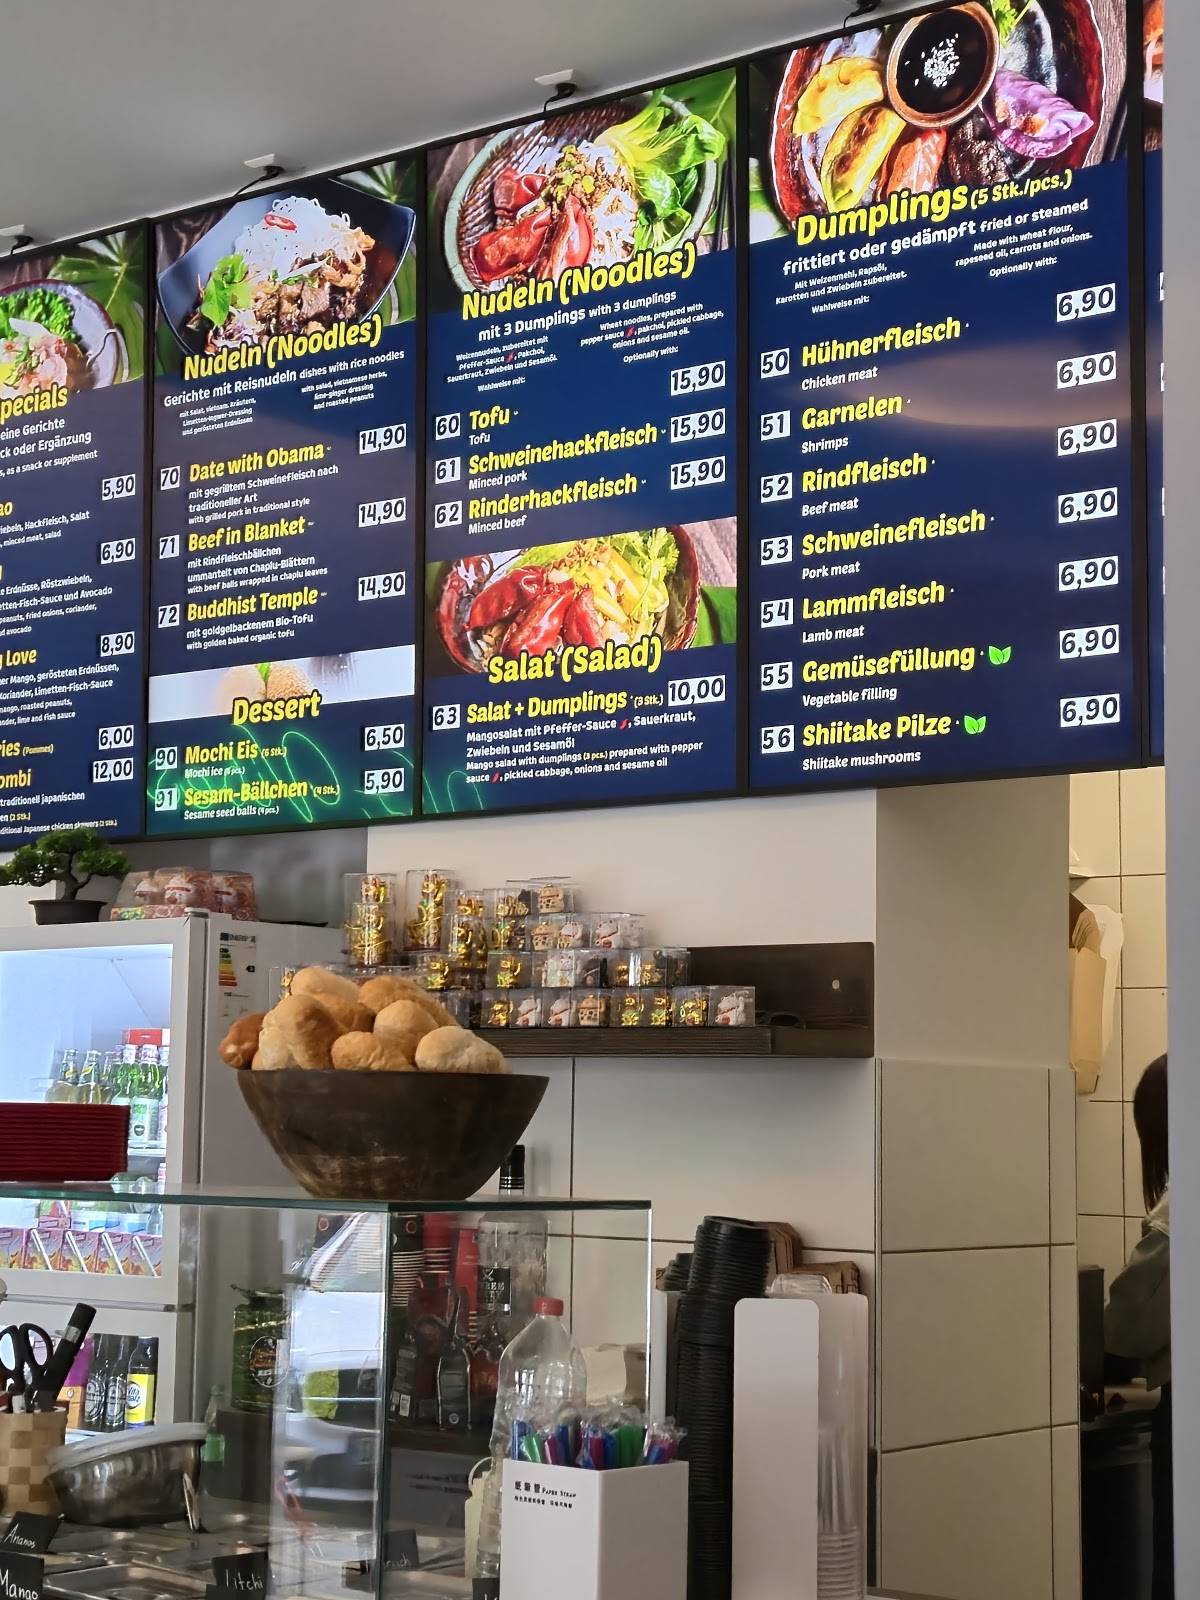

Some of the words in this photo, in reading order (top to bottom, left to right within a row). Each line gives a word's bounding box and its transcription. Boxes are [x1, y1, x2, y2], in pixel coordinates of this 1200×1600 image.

[797, 185, 968, 245] Dumplings
[971, 185, 988, 209] (5
[992, 169, 1072, 202] Stk./pcs.)
[782, 244, 846, 276] frittiert
[849, 242, 886, 261] oder
[891, 221, 976, 254] gedämpft
[980, 216, 1012, 233] fried
[1015, 211, 1028, 225] or
[1031, 199, 1088, 222] steamed
[974, 238, 998, 251] Made
[999, 234, 1018, 246] with
[1019, 228, 1047, 243] wheat
[1048, 224, 1073, 238] flour,
[462, 278, 553, 320] Nudeln
[560, 242, 696, 304] (Noodles)
[479, 326, 500, 342] mit
[504, 323, 512, 334] 3
[515, 308, 585, 334] Dumplings
[589, 305, 612, 320] with
[614, 302, 620, 312] 3
[622, 291, 676, 312] dumplings
[1059, 287, 1114, 319] 6,90
[184, 342, 261, 380] Nudeln
[267, 314, 382, 368] (Noodles)
[762, 351, 788, 374] 50
[802, 317, 961, 368] Hühnerfleisch
[164, 389, 210, 407] Gerichte
[212, 383, 232, 398] mit
[235, 370, 296, 392] Reisnudeln
[300, 364, 327, 379] dishes
[328, 360, 348, 374] with
[350, 358, 367, 370] rice
[369, 350, 404, 366] noodles
[672, 363, 724, 391] 15,90
[802, 374, 846, 391] Chicken
[848, 366, 878, 381] meat
[1059, 355, 1114, 386] 6,90
[23, 418, 65, 435] Gerichte
[437, 416, 458, 436] 60
[470, 406, 510, 430] Tofu
[672, 411, 724, 438] 15,90
[762, 414, 785, 436] 51
[802, 396, 902, 430] Garnelen
[13, 443, 36, 455] oder
[38, 431, 91, 451] Ergänzung
[361, 425, 405, 451] 14,90
[470, 433, 490, 446] Tofu
[802, 436, 848, 454] Shrimps
[1059, 422, 1115, 453] 6,90
[7, 467, 14, 475] as
[22, 462, 42, 471] snack
[54, 450, 97, 466] supplement
[162, 468, 179, 486] 70
[190, 461, 223, 482] Date
[228, 451, 263, 475] with
[267, 444, 324, 467] Obama
[437, 460, 456, 480] 61
[469, 423, 657, 474] Schweinehackfleisch
[189, 489, 203, 500] mit
[247, 469, 315, 489] Schweinefleisch
[318, 465, 338, 477] nach
[469, 474, 504, 490] Minced
[504, 470, 528, 485] pork
[672, 459, 724, 484] 15,90
[762, 476, 788, 498] 52
[802, 452, 926, 492] Rindfleisch
[104, 476, 134, 497] 5,90
[436, 504, 459, 524] 62
[469, 473, 636, 519] Rinderhackfleisch
[360, 499, 405, 525] 14,90
[802, 502, 829, 516] Beef
[831, 497, 858, 511] meat
[1060, 491, 1116, 521] 6,90
[161, 537, 176, 556] 71
[188, 528, 223, 552] Beef
[226, 528, 240, 545] in
[245, 516, 305, 542] Blanket
[469, 519, 504, 534] Minced
[504, 515, 526, 528] beef
[762, 539, 788, 561] 53
[802, 509, 986, 556] Schweinefleisch
[102, 540, 134, 561] 6,90
[802, 564, 829, 579] Pork
[831, 561, 860, 575] meat
[1061, 559, 1117, 589] 6,90
[360, 574, 404, 598] 14,90
[159, 606, 177, 625] 72
[187, 596, 256, 622] Buddhist
[260, 587, 318, 612] Temple
[762, 602, 789, 623] 54
[803, 581, 945, 619] Lammfleisch
[187, 629, 201, 639] mit
[276, 614, 313, 627] Bio-Tofu
[802, 628, 834, 643] Lamb
[837, 625, 865, 639] meat
[102, 633, 133, 655] 8,90
[1061, 627, 1117, 658] 6,90
[7, 649, 37, 666] Love
[488, 652, 554, 684] Salat
[562, 636, 662, 682] (Salad)
[762, 664, 789, 686] 55
[803, 646, 975, 683] Gemüsefüllung
[669, 678, 724, 704] 10,00
[803, 690, 859, 707] Vegetable
[861, 687, 898, 701] filling
[234, 691, 320, 725] Dessert
[434, 708, 457, 726] 63
[467, 702, 510, 724] Salat
[514, 704, 524, 716] +
[528, 690, 626, 718] Dumplings
[1063, 697, 1119, 725] 6,90
[100, 727, 132, 748] 6,00
[367, 726, 403, 748] 6,50
[467, 727, 522, 742] Mangosalat
[525, 726, 541, 736] mit
[544, 718, 616, 735] Pfeffer-Sauce
[762, 727, 791, 749] 56
[803, 719, 891, 746] Shiitake
[898, 714, 951, 738] Pilze
[156, 750, 175, 766] 90
[186, 744, 233, 764] Mochi
[237, 740, 257, 760] Eis
[466, 760, 493, 771] Mango
[495, 756, 516, 768] salad
[518, 755, 536, 765] with
[538, 752, 582, 766] dumplings
[609, 746, 648, 759] prepared
[650, 744, 669, 754] with
[672, 740, 703, 752] pepper
[803, 756, 848, 770] Shiitake
[850, 750, 921, 766] mushrooms
[94, 760, 132, 780] 12,00
[366, 771, 402, 793] 5,90
[41, 792, 85, 804] japanischen
[156, 791, 174, 808] 91
[185, 781, 307, 806] Sesam-Bällchen
